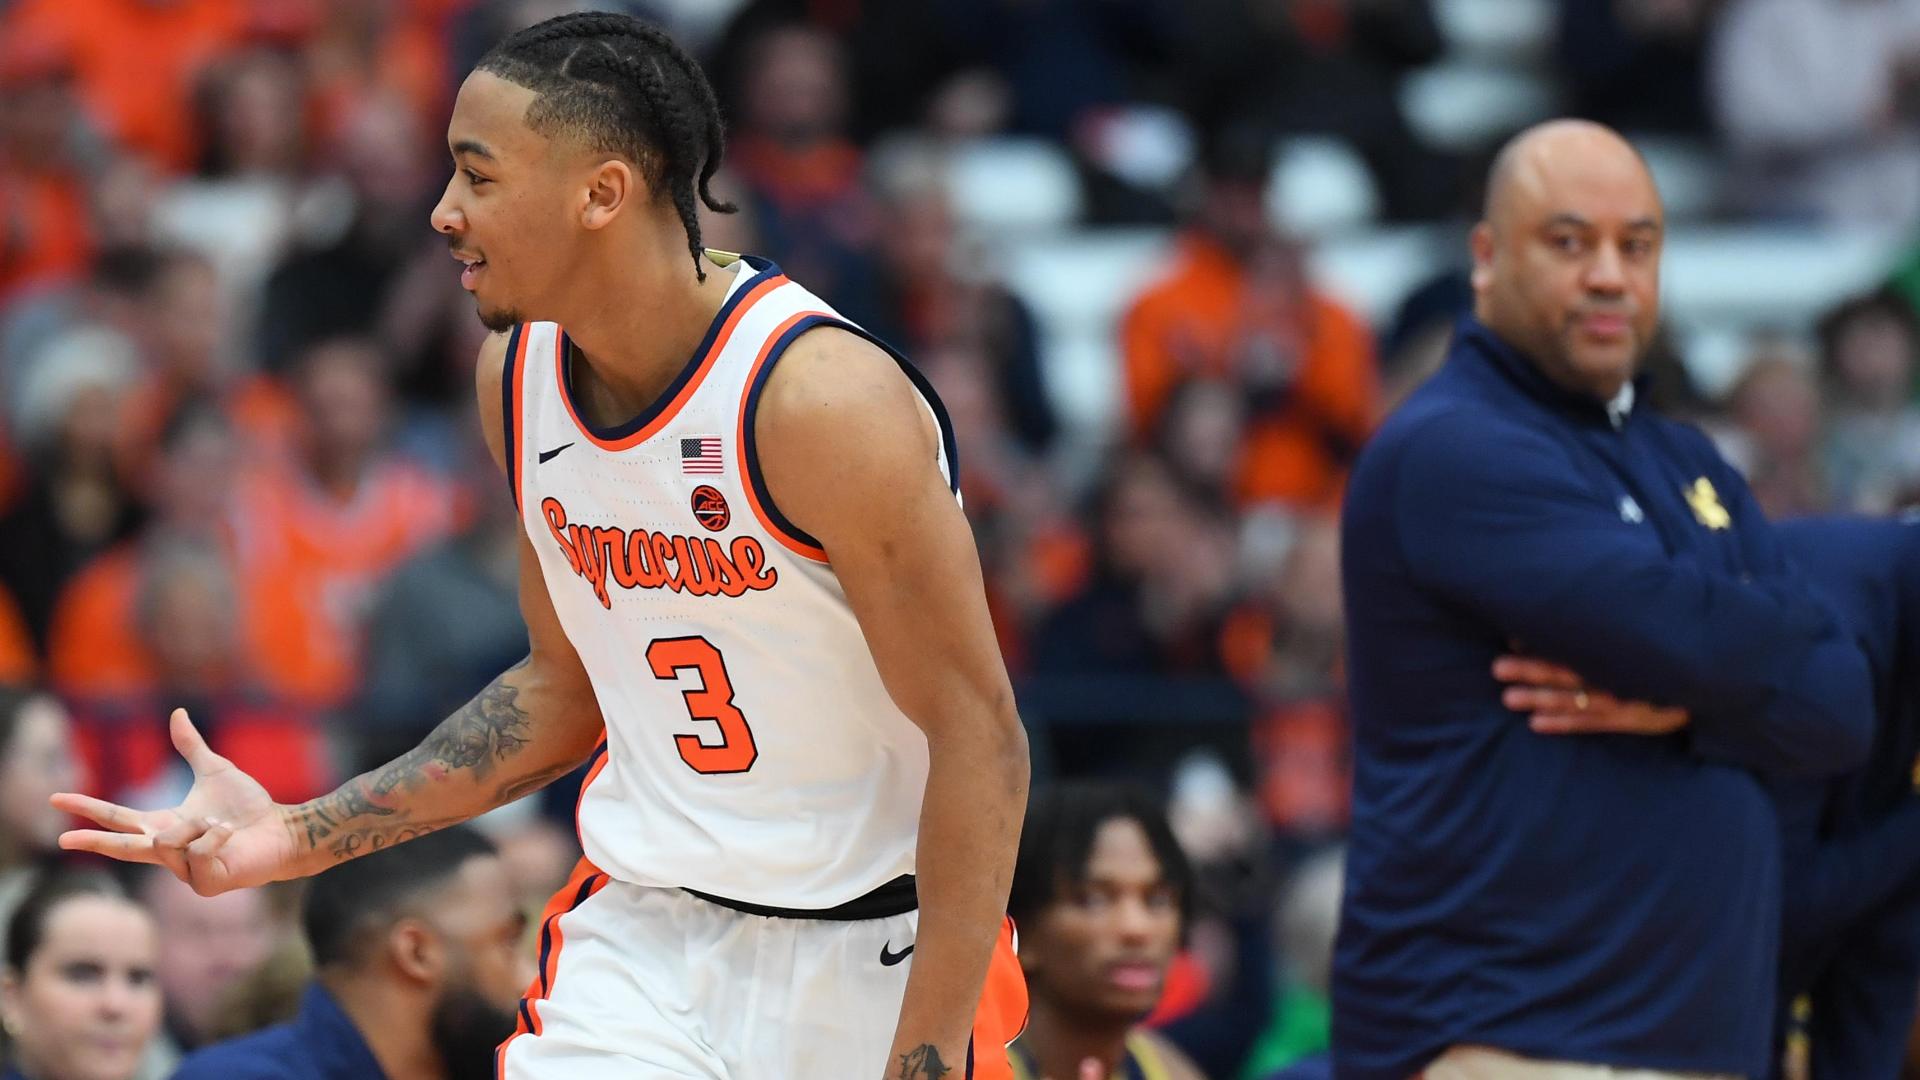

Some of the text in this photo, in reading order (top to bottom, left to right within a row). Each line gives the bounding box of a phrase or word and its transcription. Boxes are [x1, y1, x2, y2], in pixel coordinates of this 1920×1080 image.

[541, 497, 777, 610] Syracuse
[698, 501, 724, 511] ACC
[645, 635, 758, 774] 3
